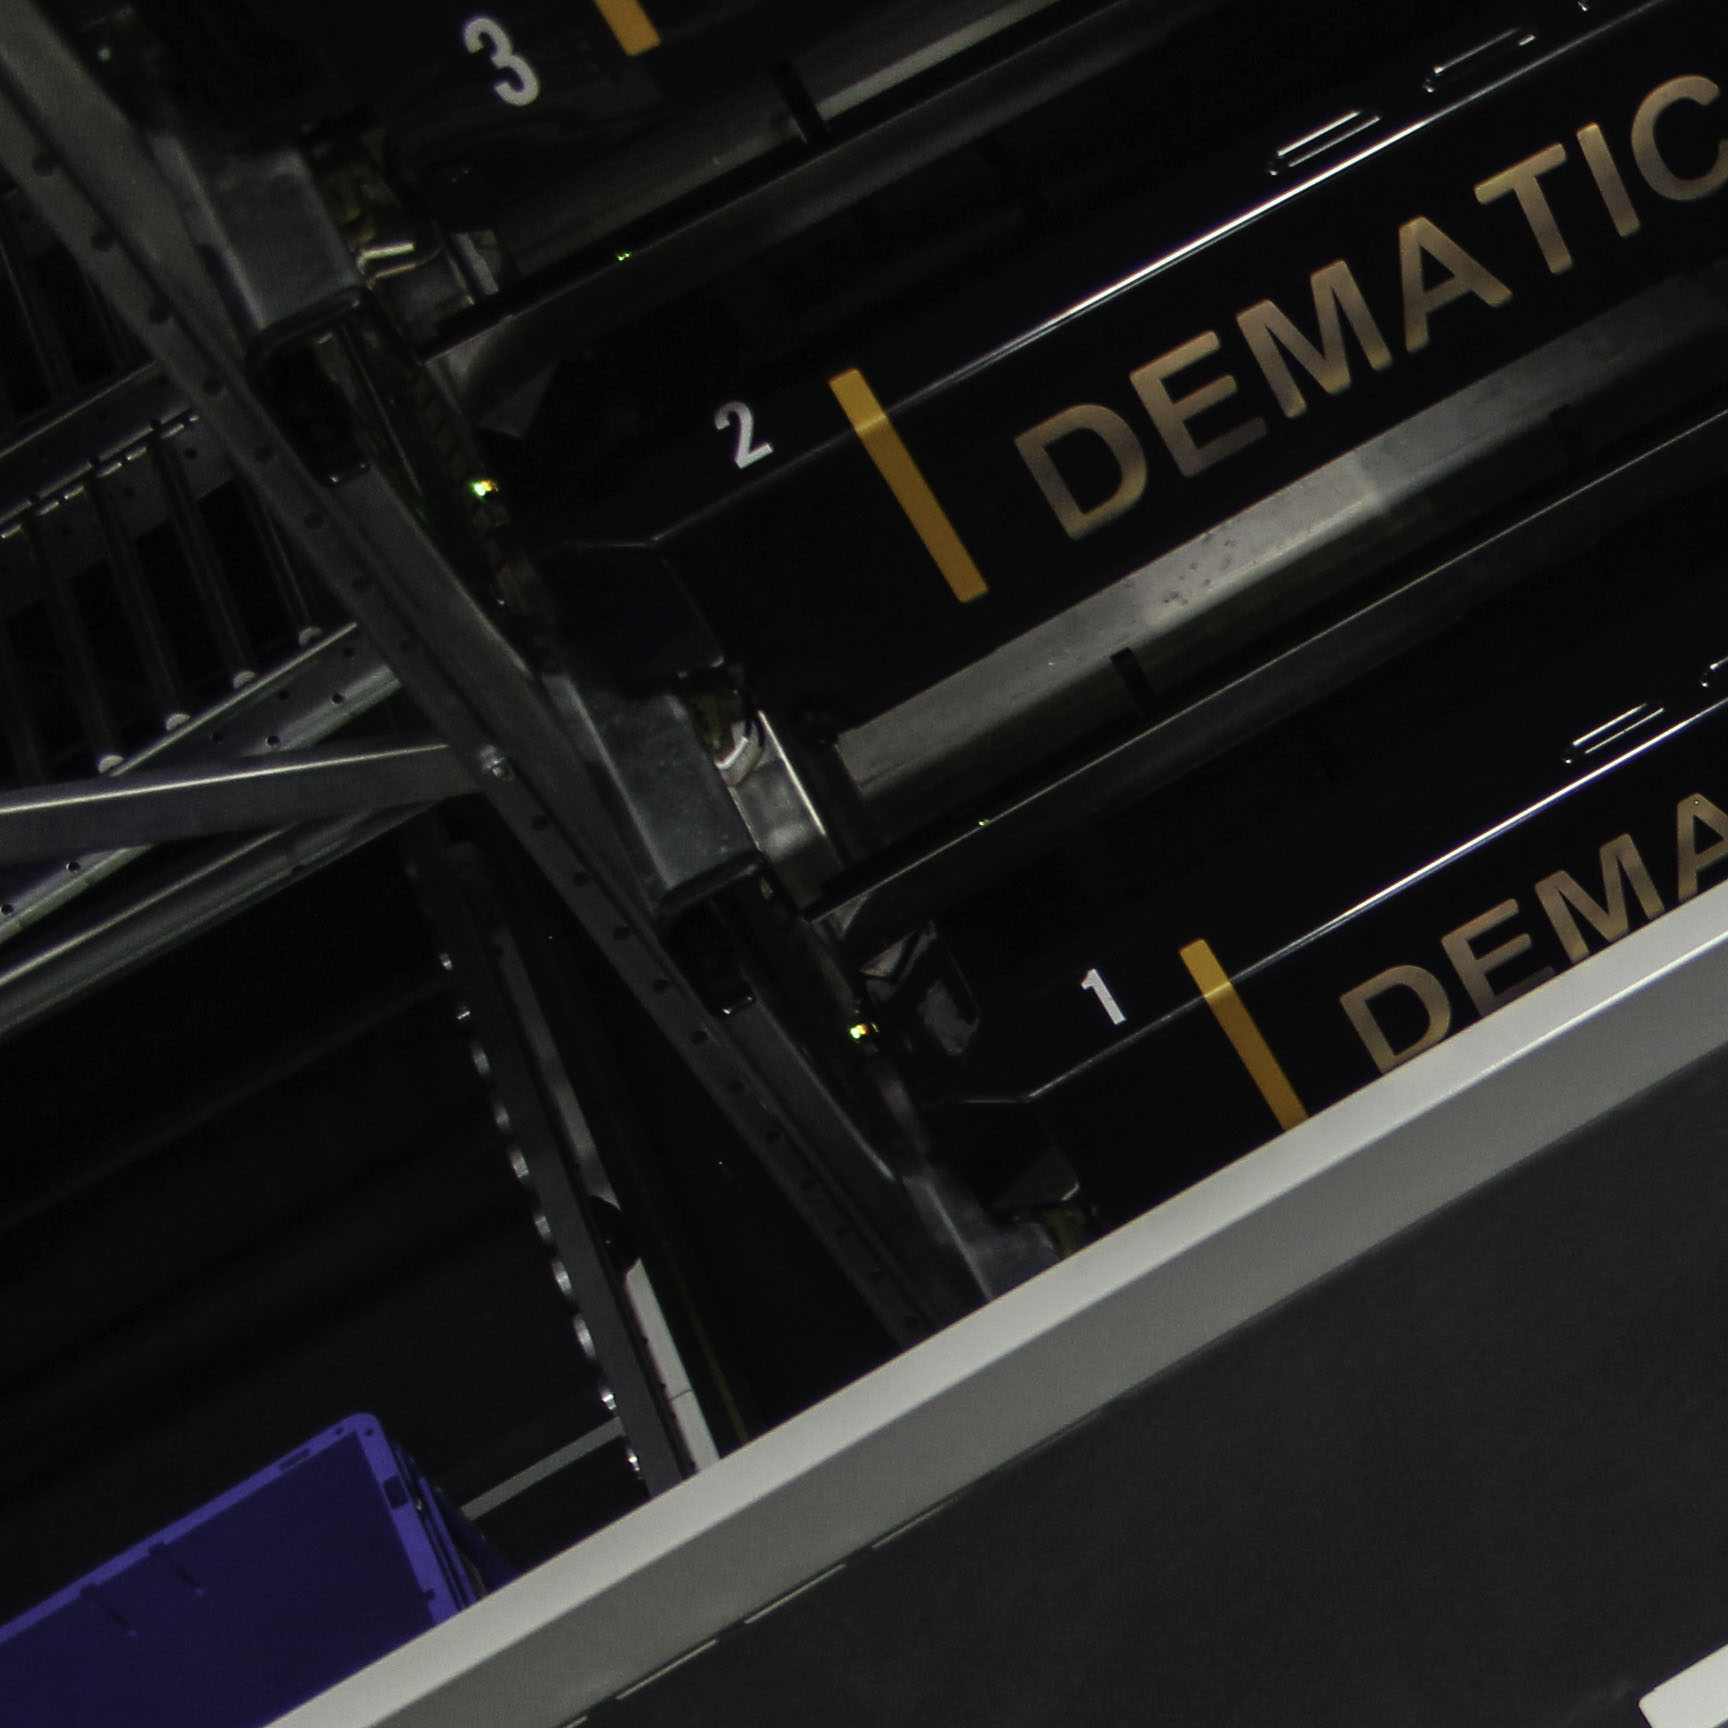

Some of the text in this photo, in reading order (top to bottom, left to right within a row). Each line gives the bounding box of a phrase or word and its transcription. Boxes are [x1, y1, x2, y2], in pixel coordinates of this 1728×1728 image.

[464, 17, 540, 106] 3
[715, 402, 774, 469] 2
[1081, 968, 1126, 1025] 1
